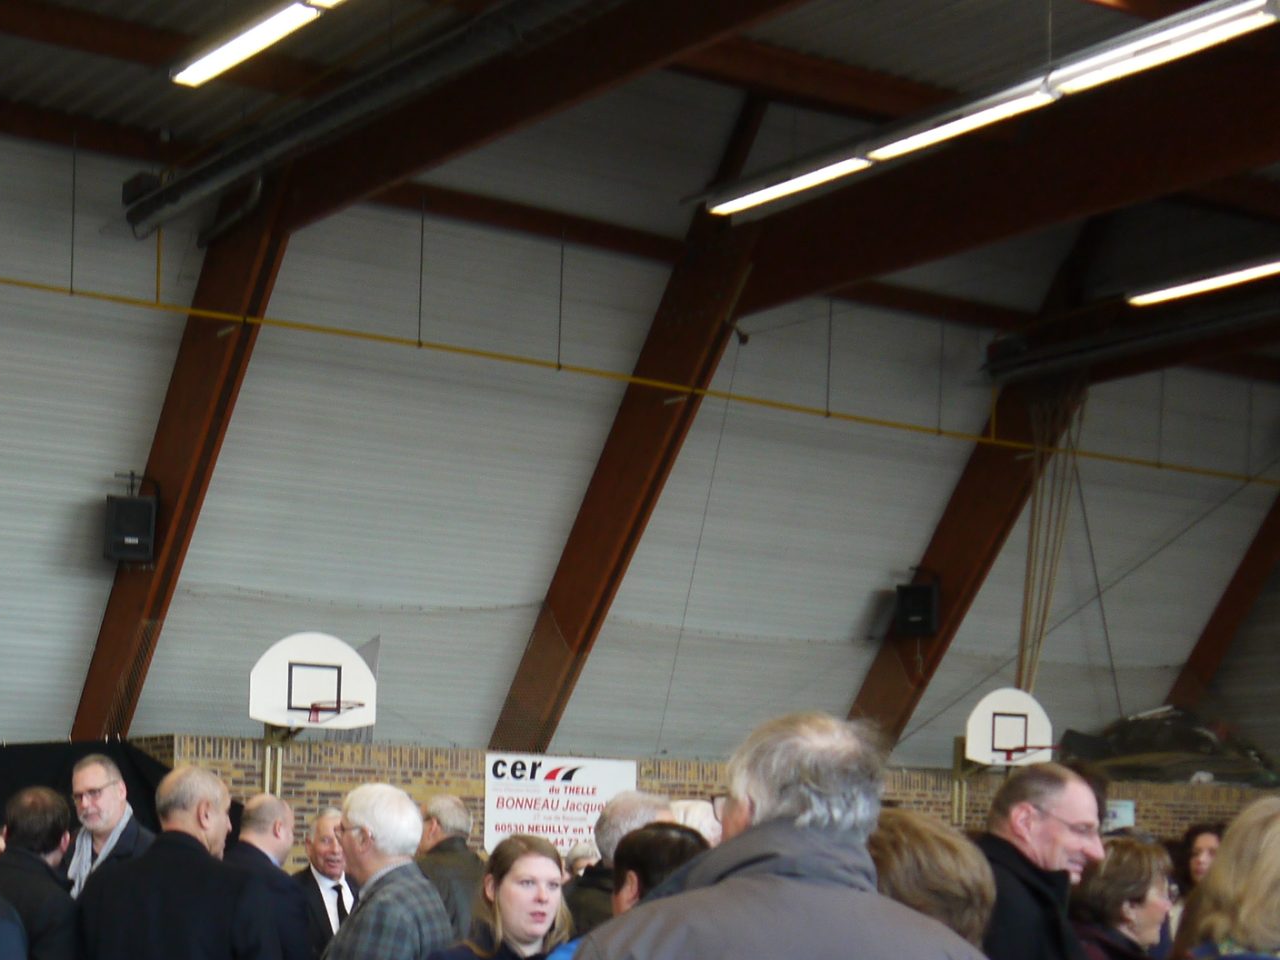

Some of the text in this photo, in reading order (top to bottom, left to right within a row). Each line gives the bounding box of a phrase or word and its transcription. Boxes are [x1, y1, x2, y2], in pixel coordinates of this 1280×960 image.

[564, 786, 596, 795] THELLE
[496, 797, 560, 811] BONNEAU
[527, 824, 569, 834] NEUILLY
